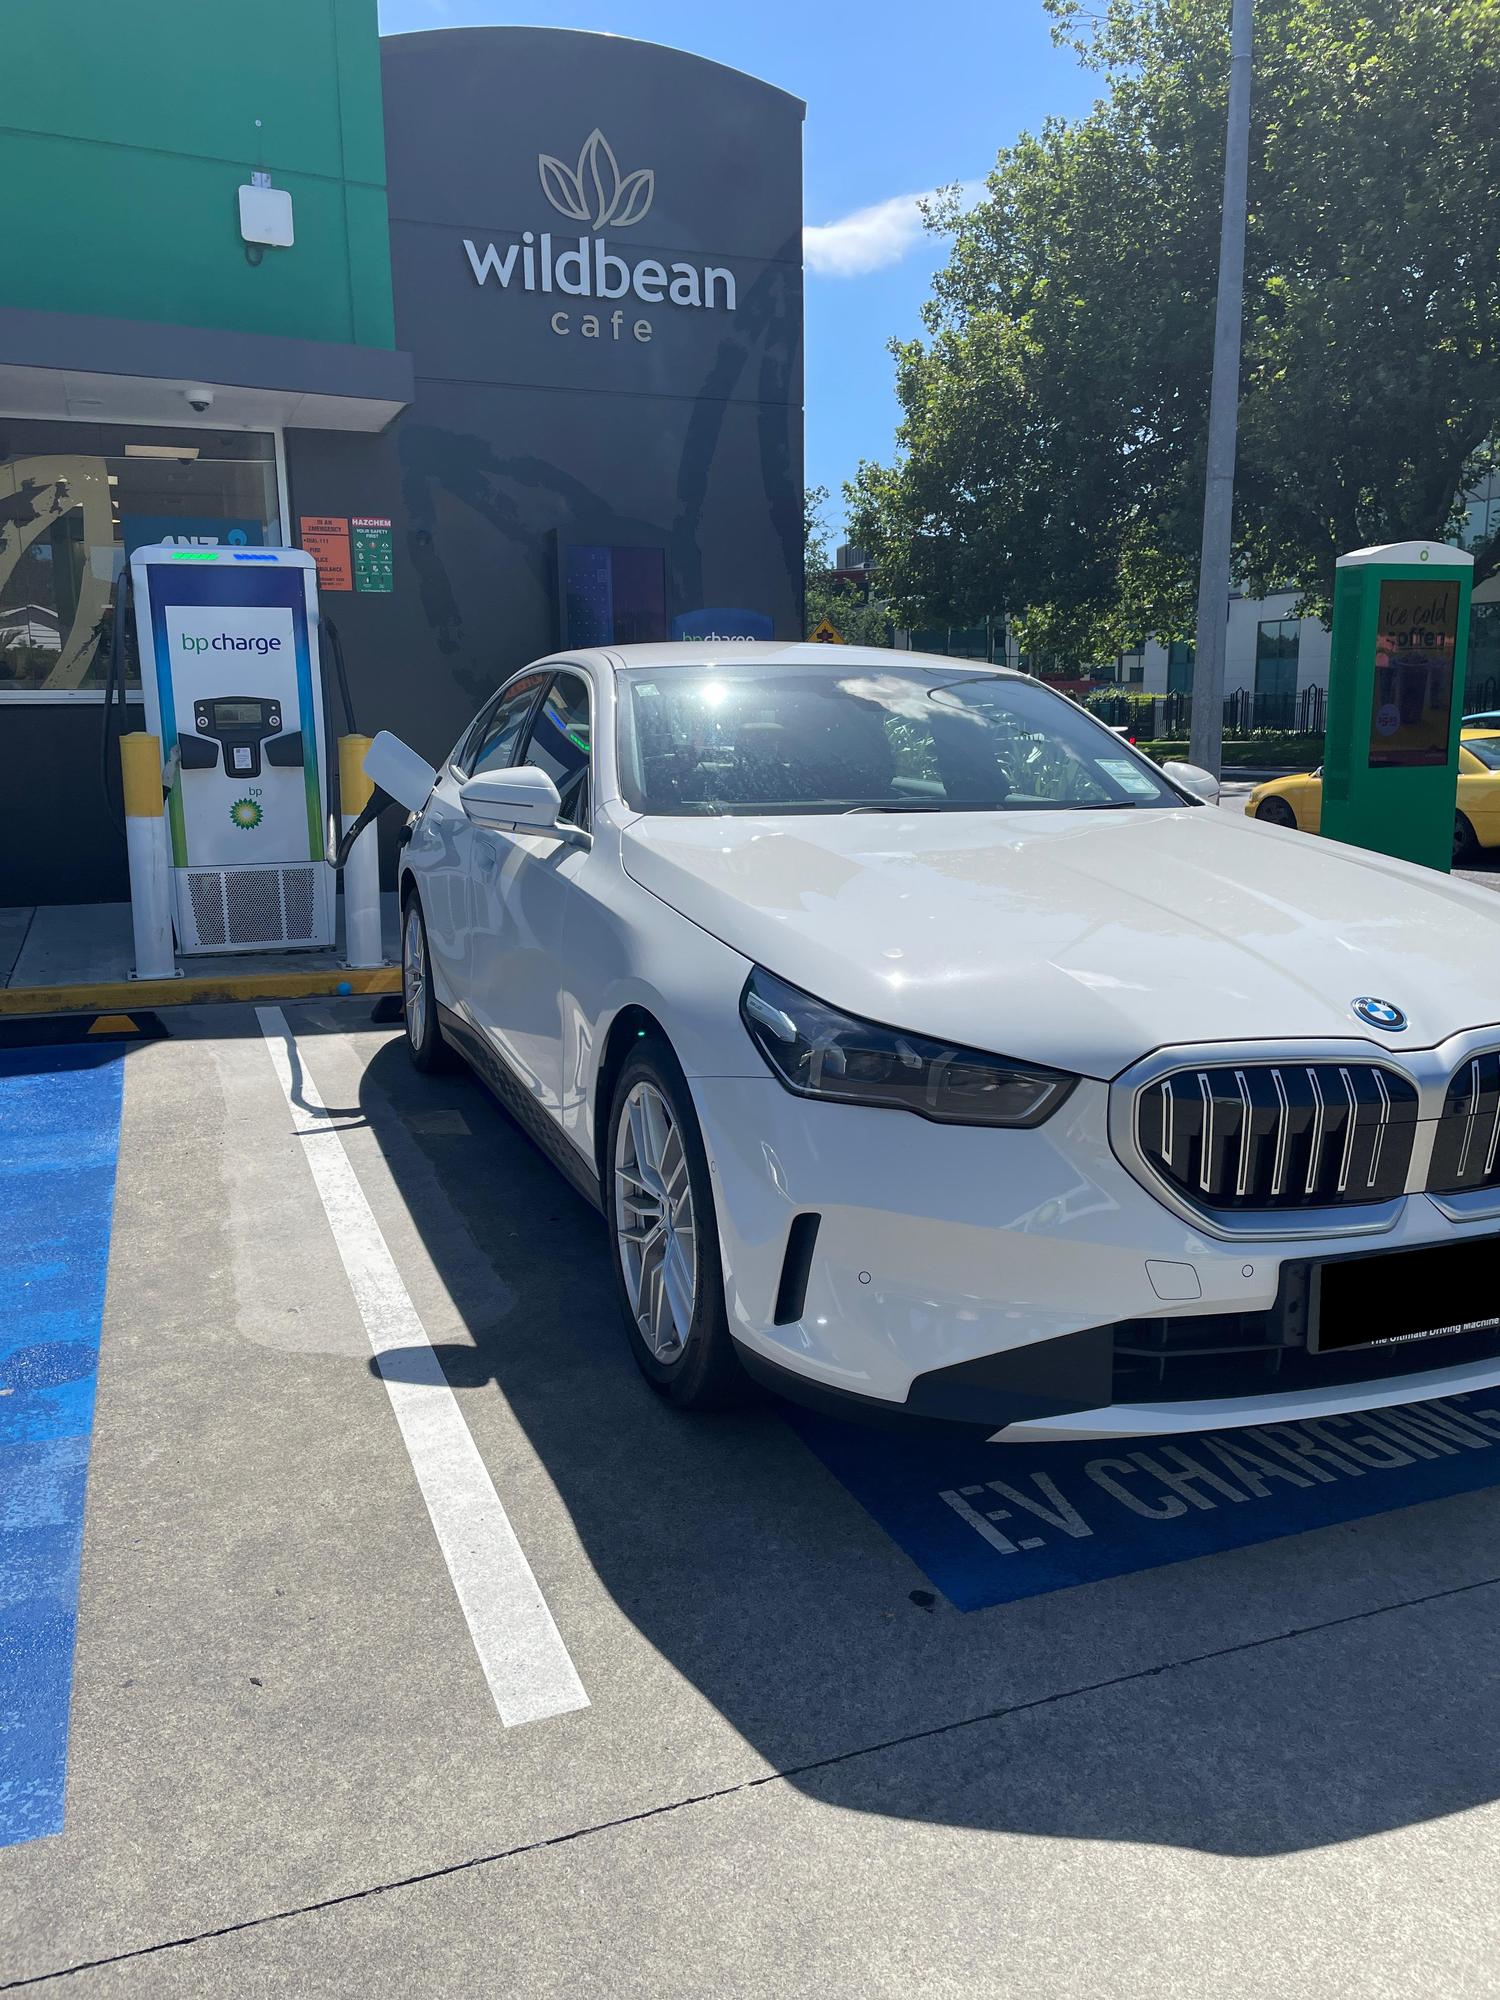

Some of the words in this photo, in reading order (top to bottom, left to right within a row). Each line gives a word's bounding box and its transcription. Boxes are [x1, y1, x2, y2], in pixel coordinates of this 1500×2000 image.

[462, 231, 737, 311] wildbean
[550, 310, 653, 342] cafe
[352, 519, 391, 527] HAZCHEM
[1385, 605, 1408, 626] ice
[1412, 592, 1449, 626] cold
[181, 633, 209, 655] bp
[211, 633, 282, 655] charge
[248, 787, 263, 798] bp
[1371, 1337, 1388, 1345] he
[1429, 1323, 1462, 1336] Driving
[1463, 1317, 1500, 1330] Machine
[938, 1471, 1094, 1555] EV
